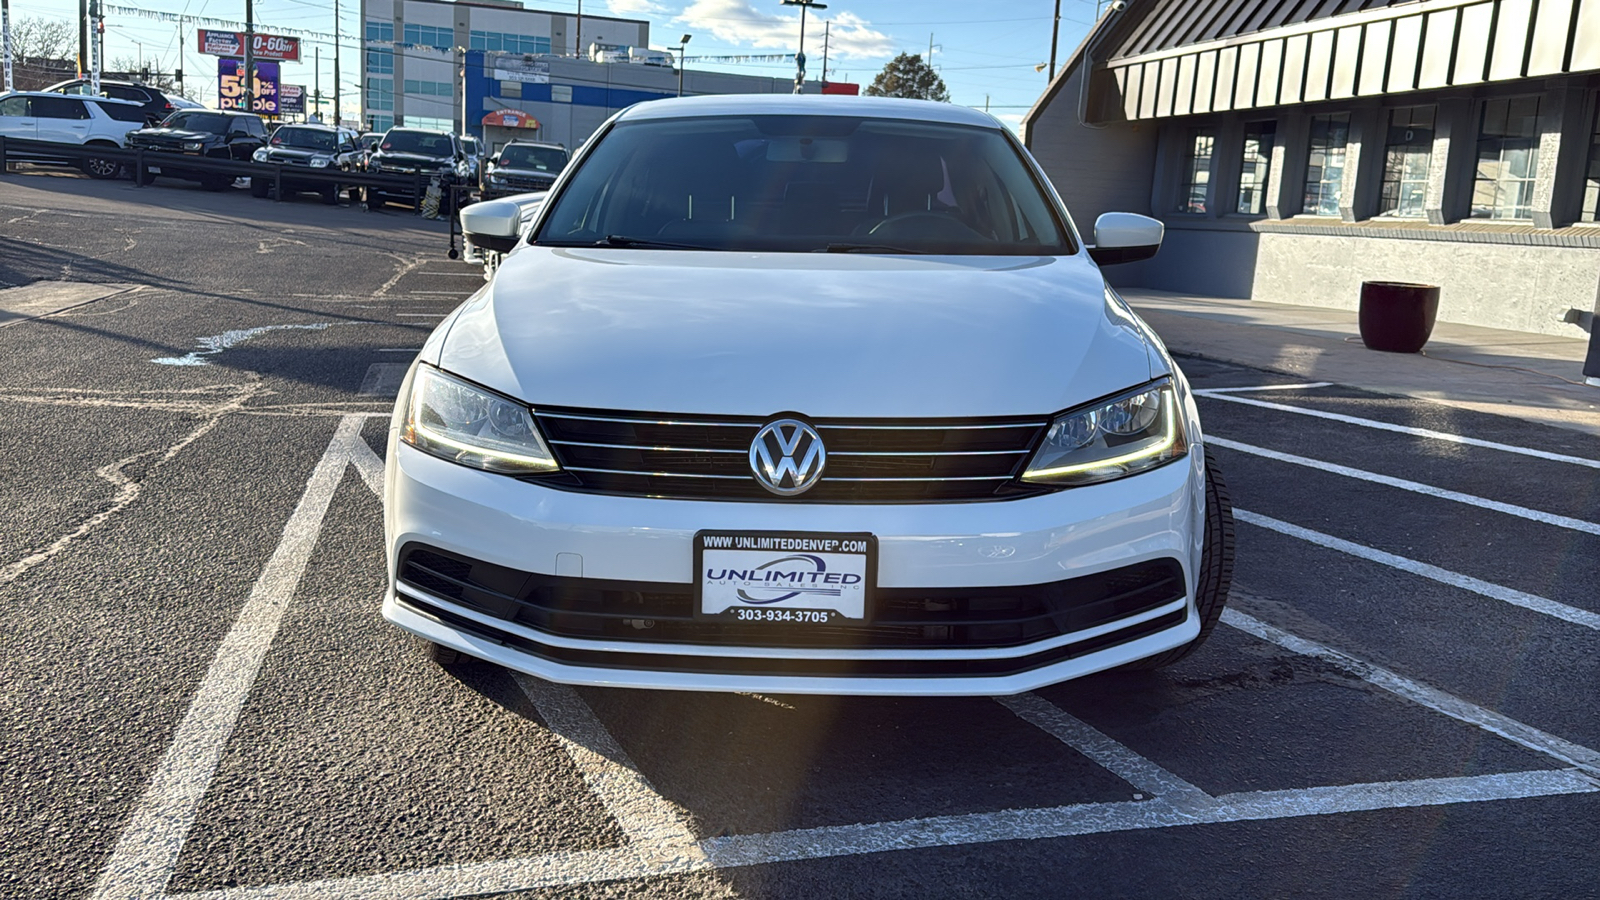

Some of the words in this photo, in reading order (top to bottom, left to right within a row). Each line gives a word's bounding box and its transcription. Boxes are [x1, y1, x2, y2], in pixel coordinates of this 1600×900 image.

[220, 97, 276, 112] puple
[496, 109, 527, 118] ENTRANCE
[750, 419, 826, 496] VW
[706, 568, 862, 584] UNLIMITED
[737, 609, 828, 623] 303-934-3705
